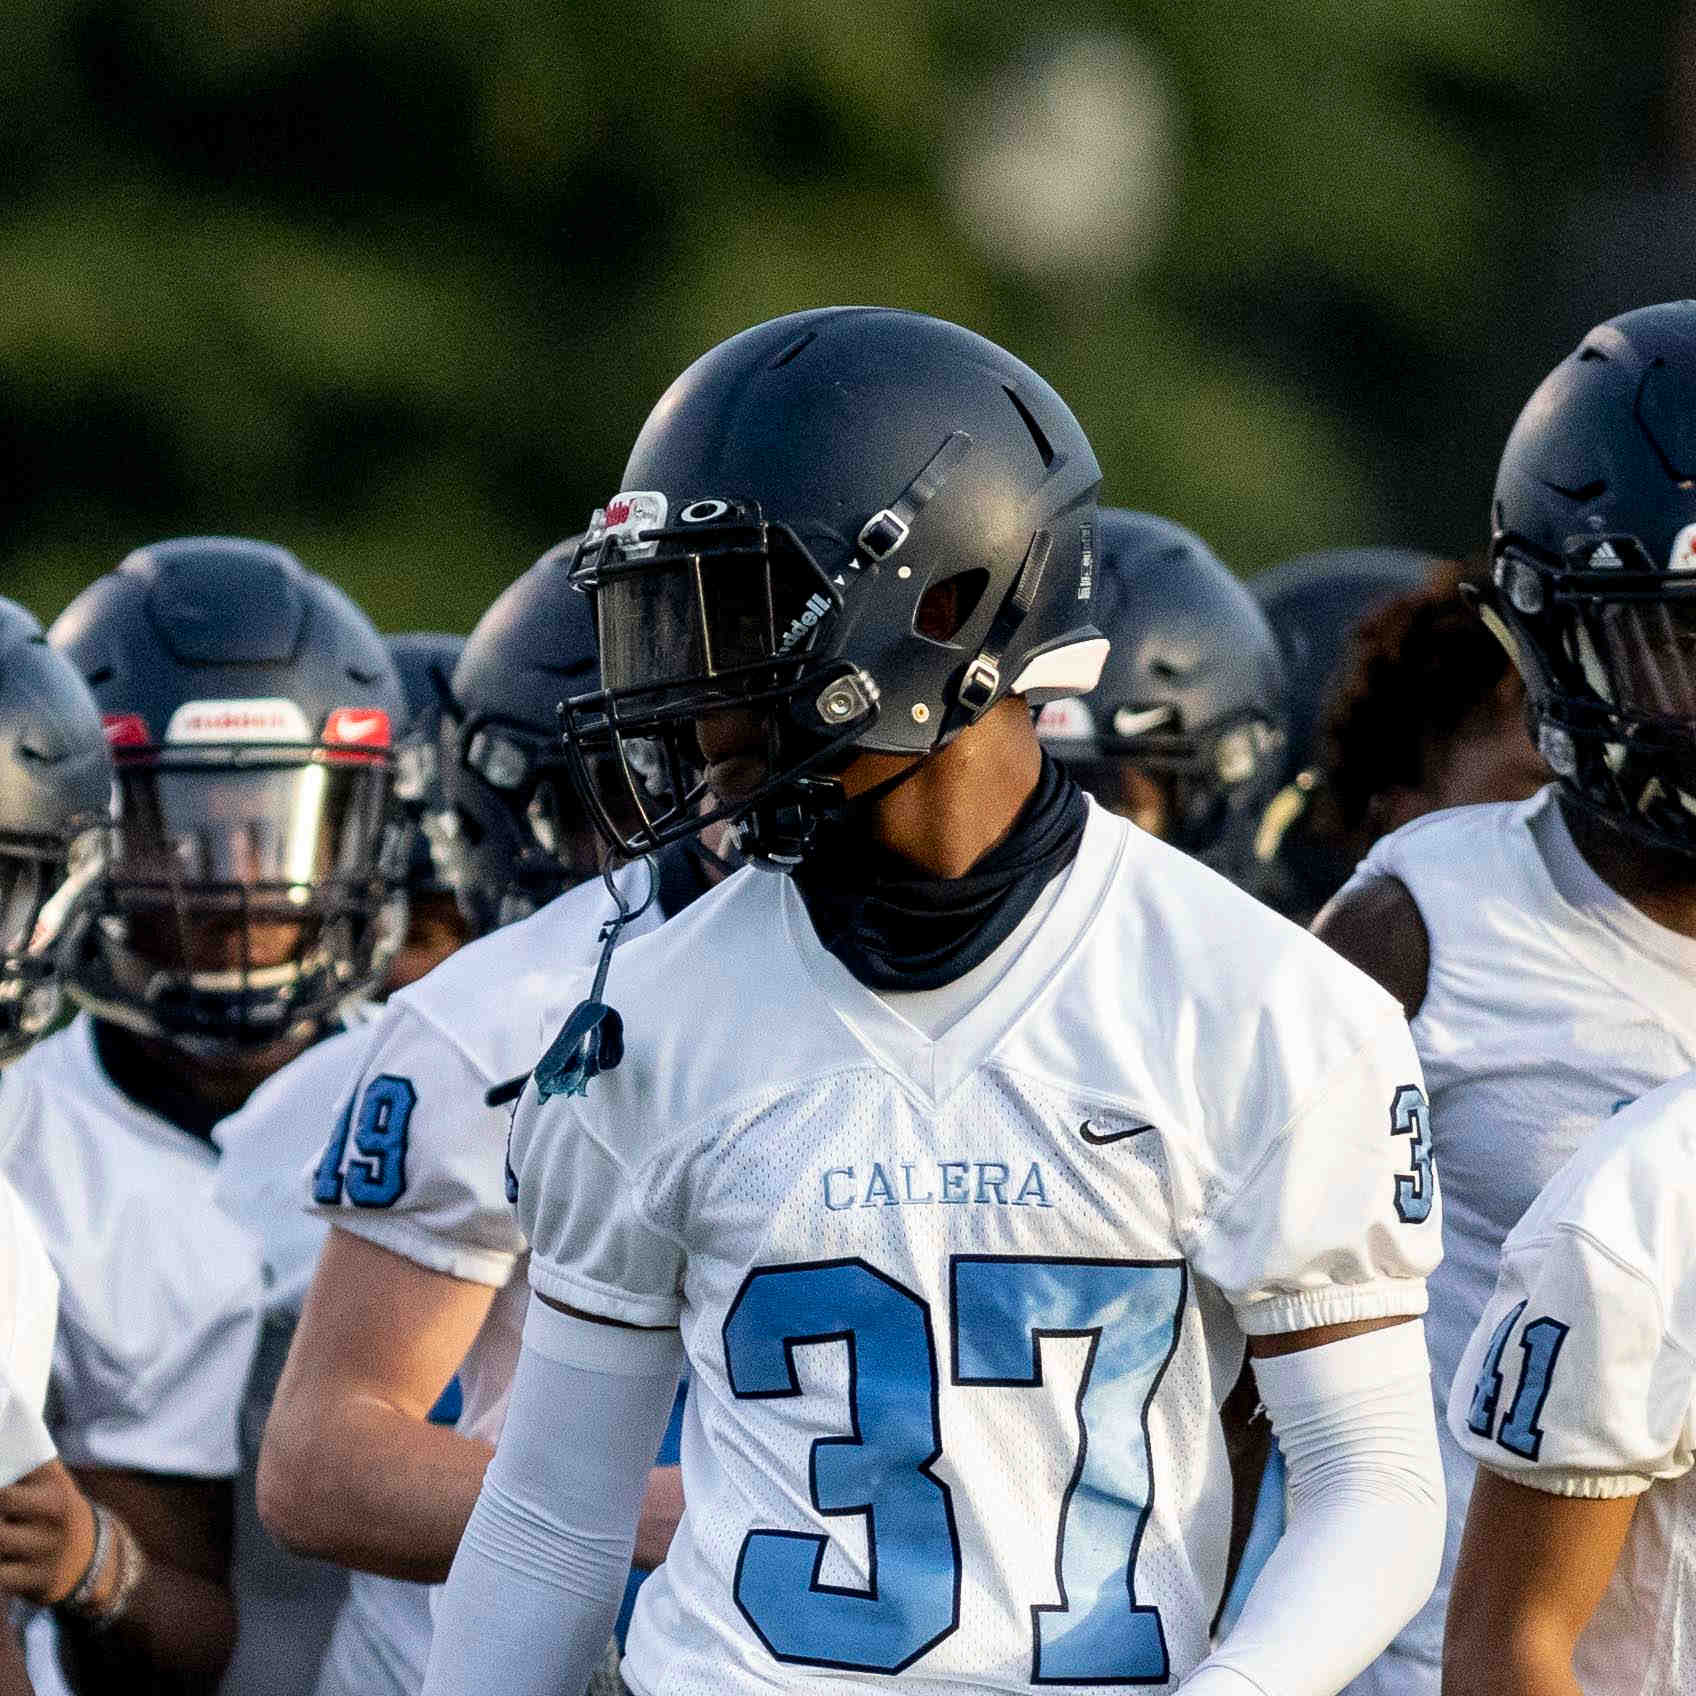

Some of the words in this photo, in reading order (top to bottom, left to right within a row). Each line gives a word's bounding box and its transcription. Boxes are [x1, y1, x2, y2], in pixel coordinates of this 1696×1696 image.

[313, 1075, 418, 1209] 19
[821, 1160, 1055, 1211] CALERA
[1390, 1083, 1435, 1225] 3
[1467, 1300, 1569, 1462] 41
[722, 1255, 1189, 1685] 37
